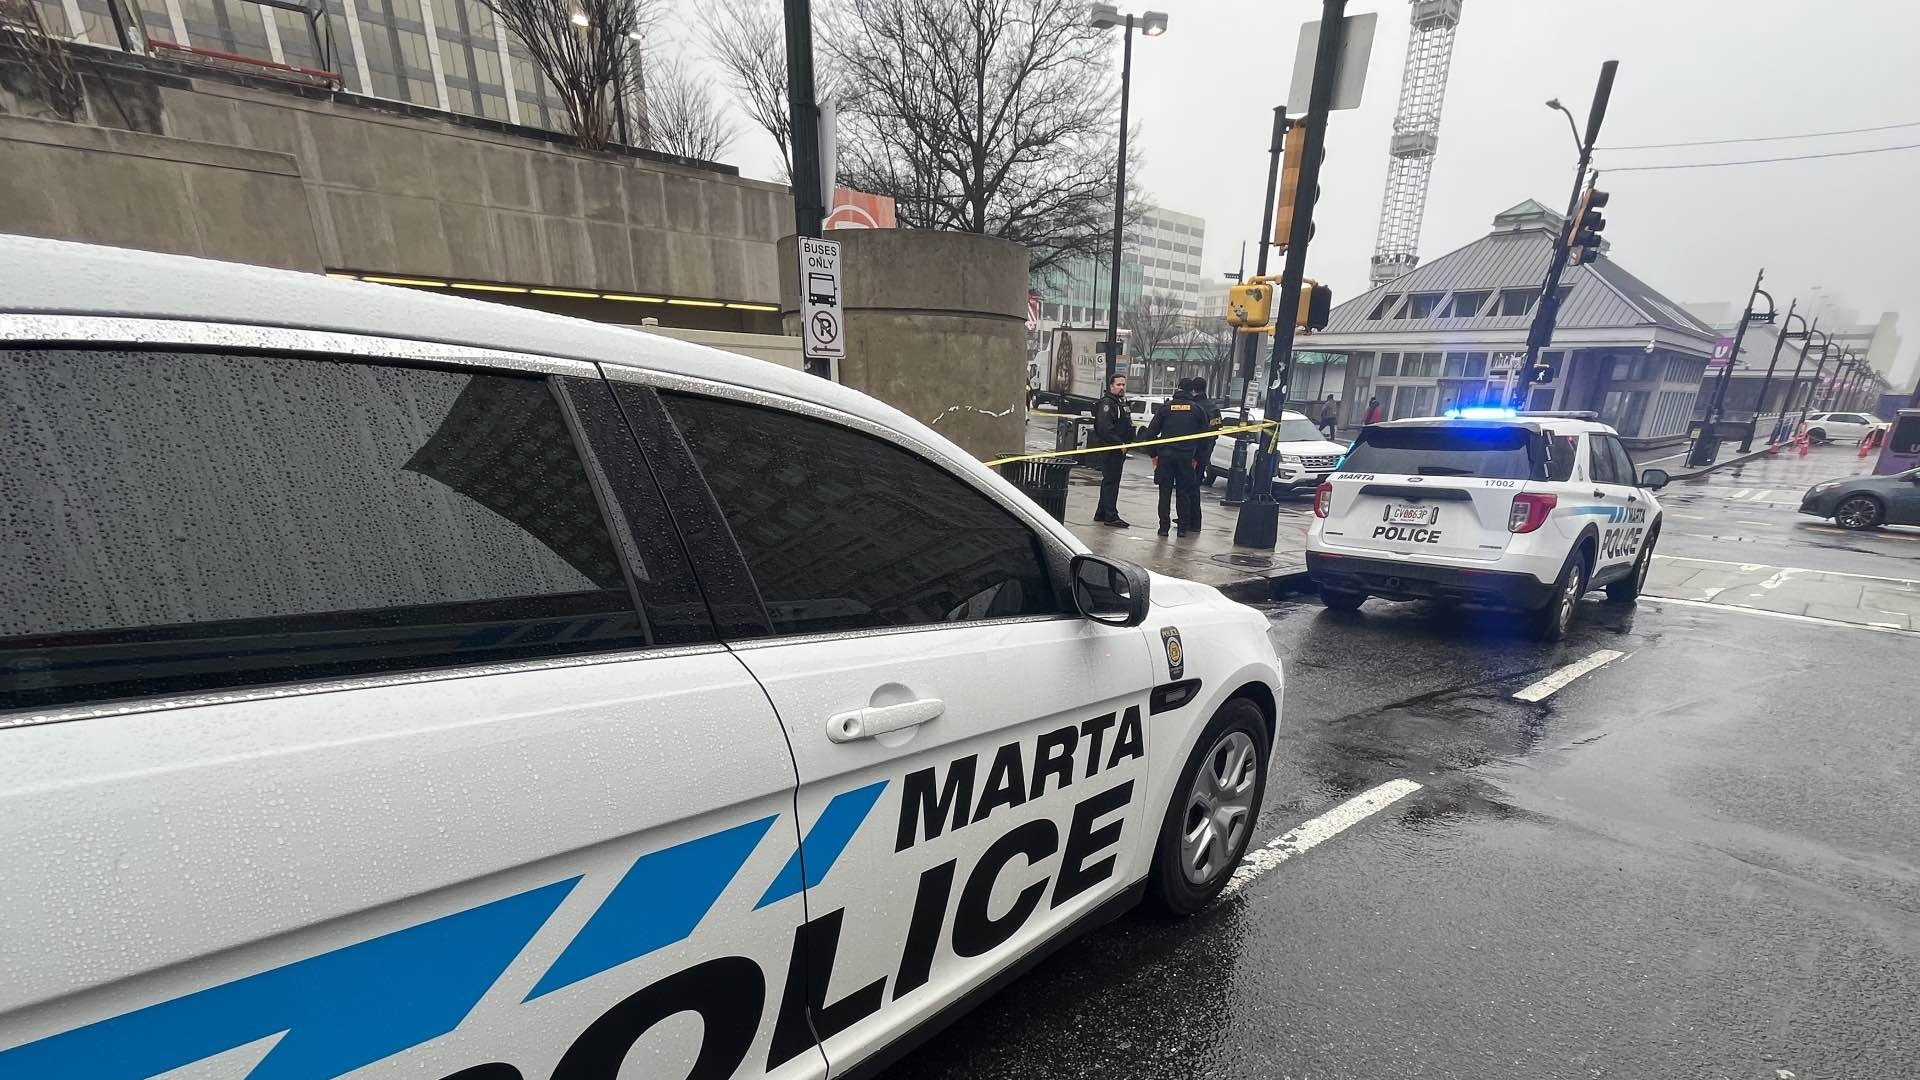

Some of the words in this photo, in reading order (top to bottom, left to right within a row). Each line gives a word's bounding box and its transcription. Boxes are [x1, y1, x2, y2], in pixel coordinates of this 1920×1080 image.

[804, 243, 837, 256] BUSES
[808, 257, 834, 269] ONLY
[1372, 526, 1441, 543] POLICE
[1600, 527, 1643, 560] POLICE
[894, 704, 1145, 853] MARTA
[438, 778, 1135, 1080] OLICE
